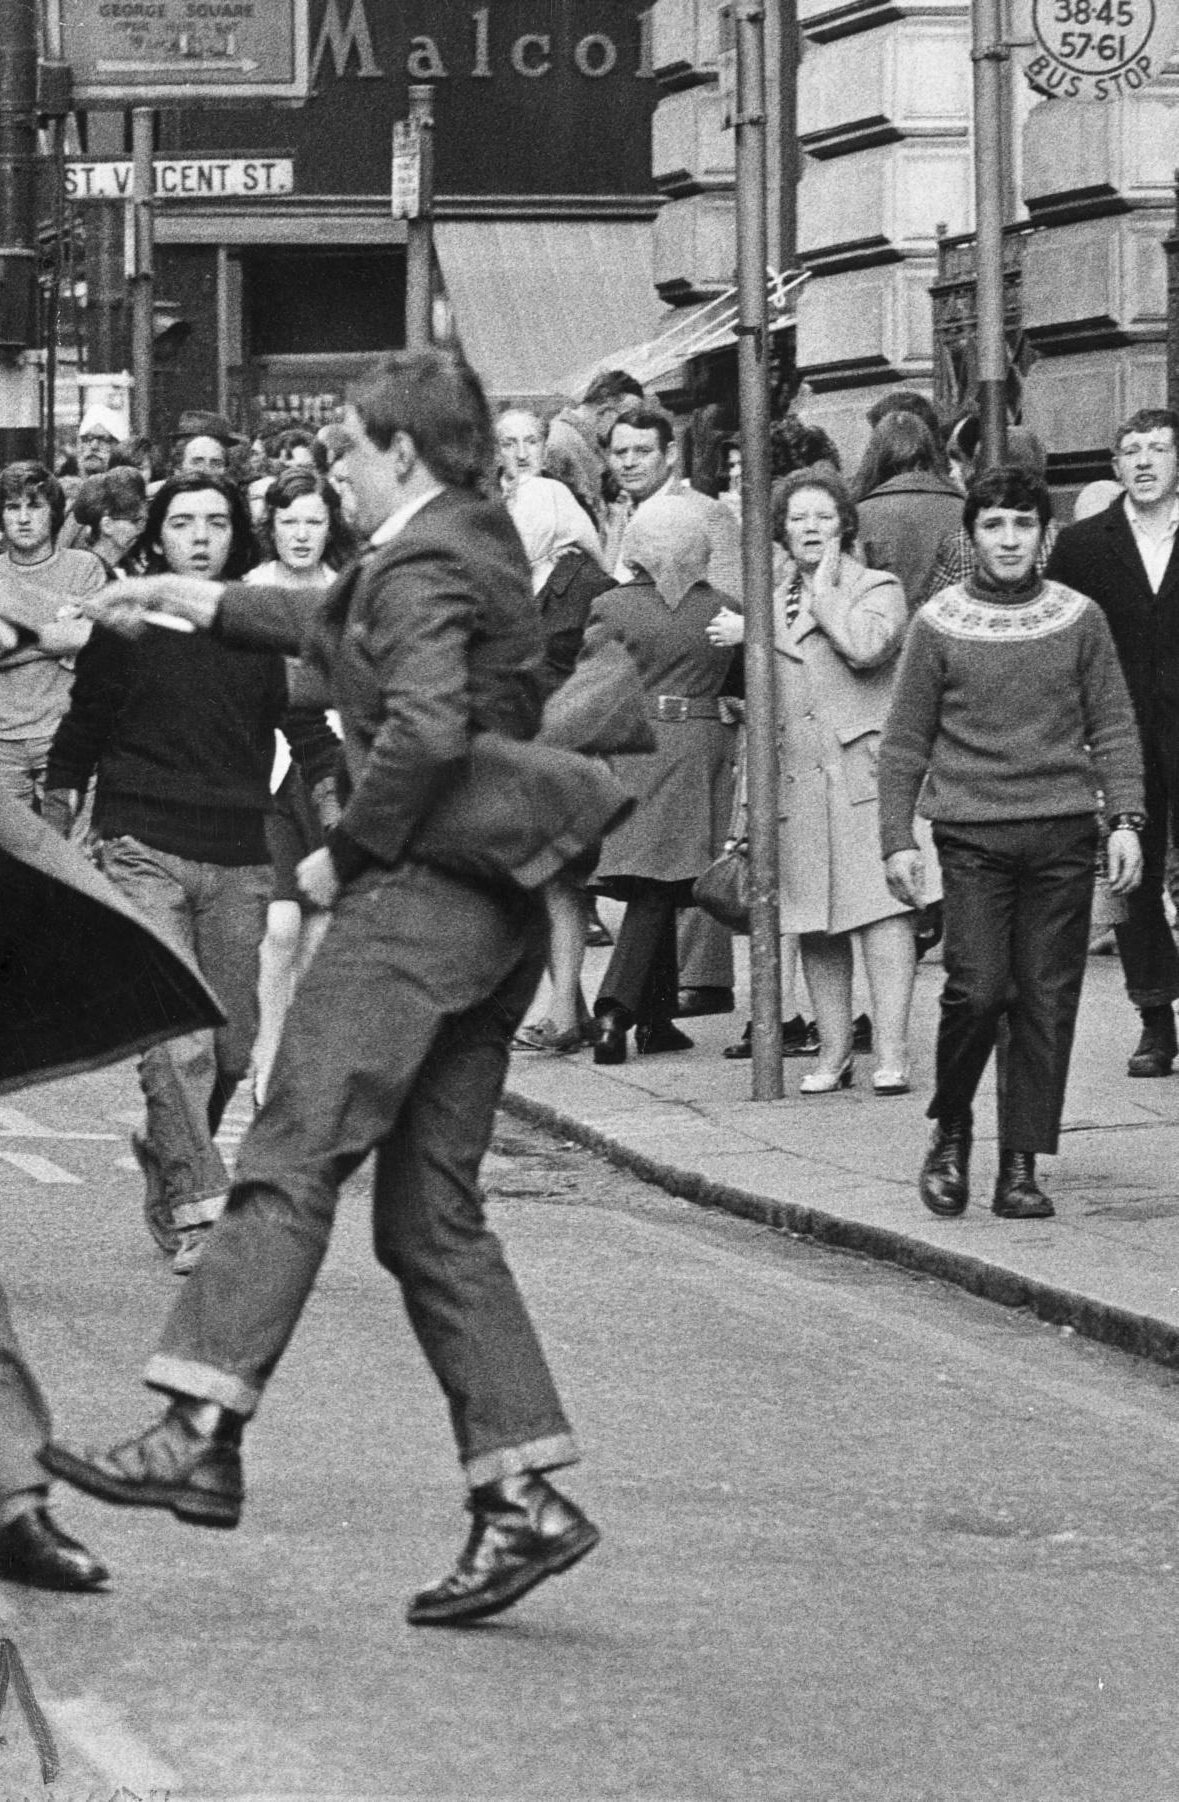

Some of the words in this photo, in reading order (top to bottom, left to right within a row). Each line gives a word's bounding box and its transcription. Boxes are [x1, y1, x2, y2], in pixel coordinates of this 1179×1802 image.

[99, 3, 166, 18] GEORGE
[186, 3, 255, 18] SQUARE
[1028, 54, 1083, 97] BUS
[1094, 56, 1151, 100] STOP
[65, 167, 104, 195] ST.
[114, 165, 229, 194] VCENT
[244, 163, 285, 191] ST.
